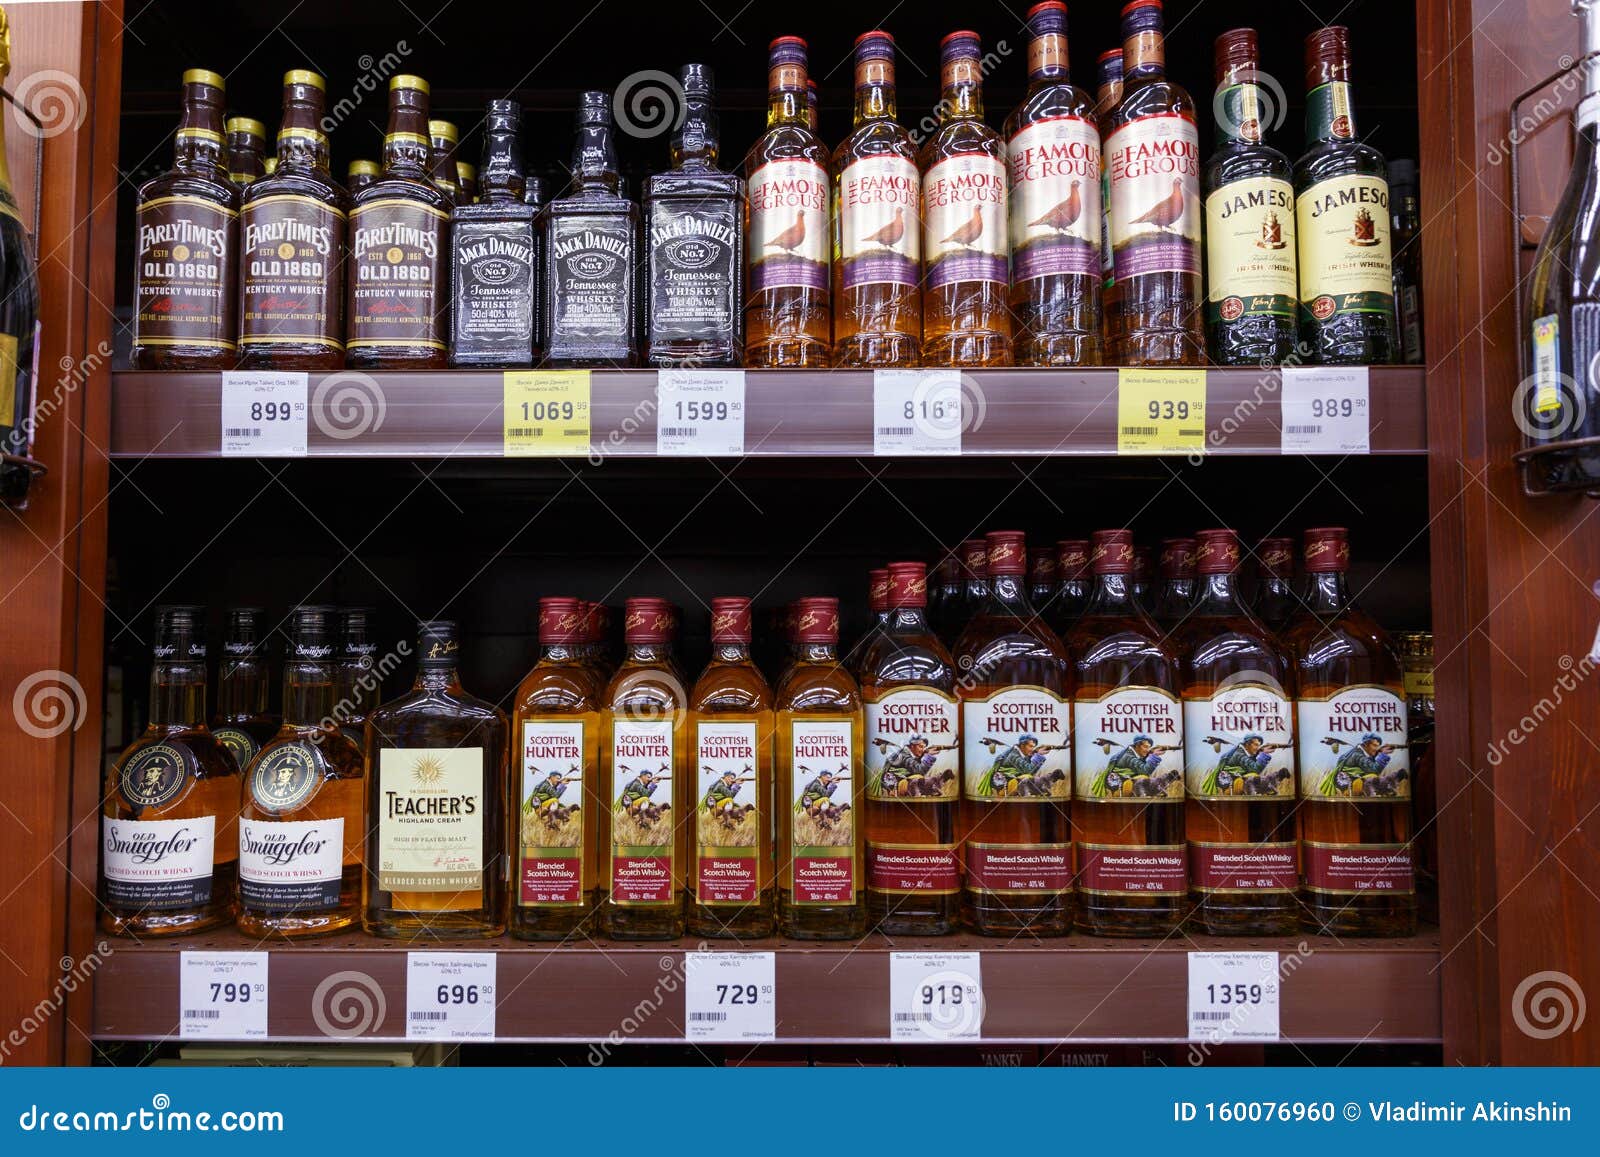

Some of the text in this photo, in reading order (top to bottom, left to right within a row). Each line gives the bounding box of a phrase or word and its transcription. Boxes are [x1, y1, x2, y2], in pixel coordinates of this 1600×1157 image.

[762, 179, 826, 196] FAMOUS
[860, 174, 919, 195] FAMOUS
[937, 173, 1003, 194] FAMOUS
[761, 193, 826, 213] GROUSE
[936, 187, 1004, 208] GROUSE
[1311, 186, 1389, 218] JAMESO
[651, 222, 684, 247] JACK
[458, 243, 486, 266] JACK
[555, 238, 581, 260] JACK
[679, 248, 706, 258] No.7
[144, 262, 218, 280] OLD 1860
[251, 261, 323, 278] OLD 1860
[360, 265, 430, 281] OLD 1860
[664, 268, 722, 281] Tennessee
[246, 284, 328, 296] KENTUCKY WHISKEY
[470, 284, 521, 296] Tennessee
[566, 279, 618, 290] Tennessee
[140, 286, 223, 298] KENTUCKY WHISKEY
[355, 288, 436, 299] KENTUCKY WHISKEY
[664, 287, 720, 296] WHISKEY
[470, 301, 520, 309] WHISKEY
[566, 296, 616, 304] WHISKEY
[251, 402, 291, 421] 899
[521, 401, 573, 421] 1069
[675, 401, 728, 421] 1599
[904, 400, 944, 420] 816
[1149, 400, 1189, 420] 939
[1312, 398, 1353, 418] 989
[883, 704, 944, 715] SCOTTISH
[992, 703, 1054, 714] SCOTTISH
[1106, 703, 1169, 715] SCOTTISH
[1216, 702, 1279, 713] SCOTTISH
[1334, 702, 1396, 714] SCOTTISH
[878, 718, 950, 733] HUNTER
[987, 717, 1061, 733] HUNTER
[1100, 717, 1176, 733] HUNTER
[1211, 715, 1286, 731] HUNTER
[1328, 716, 1403, 732] HUNTER
[530, 736, 575, 745] SCOTTISH
[620, 735, 665, 744] SCOTTISH
[703, 736, 748, 745] SCOTTISH
[799, 735, 844, 744] SCOTTISH
[525, 746, 579, 758] HUNTER
[616, 745, 670, 757] HUNTER
[700, 747, 753, 758] HUNTER
[795, 746, 849, 757] HUNTER
[386, 791, 476, 819] TEACHER'S
[132, 832, 156, 842] OLD
[264, 832, 287, 842] OLD
[107, 826, 198, 864] Smuggler
[241, 826, 327, 865] Smuggler
[876, 855, 953, 865] Blended Scotch Whisky
[986, 855, 1065, 864] Blended Scotch Whisky
[1103, 857, 1182, 866] Blended Scotch Whisky
[1213, 854, 1292, 863] Blended Scotch Whisky
[1331, 855, 1411, 865] Blended Scotch Whisky
[537, 862, 565, 870] Blended
[713, 861, 741, 869] Blended
[809, 861, 837, 869] Blended
[527, 870, 575, 878] Scotch Whisky
[641, 869, 666, 877] Whisky
[703, 869, 751, 878] Scotch Whisky
[799, 869, 848, 878] Scotch Whisky
[384, 876, 479, 886] BLENDED SCOTCH WHISKY
[210, 983, 251, 1003] 799
[437, 984, 479, 1004] 696
[716, 984, 772, 1005] 729 90
[922, 984, 963, 1005] 919
[1207, 984, 1262, 1004] 1359
